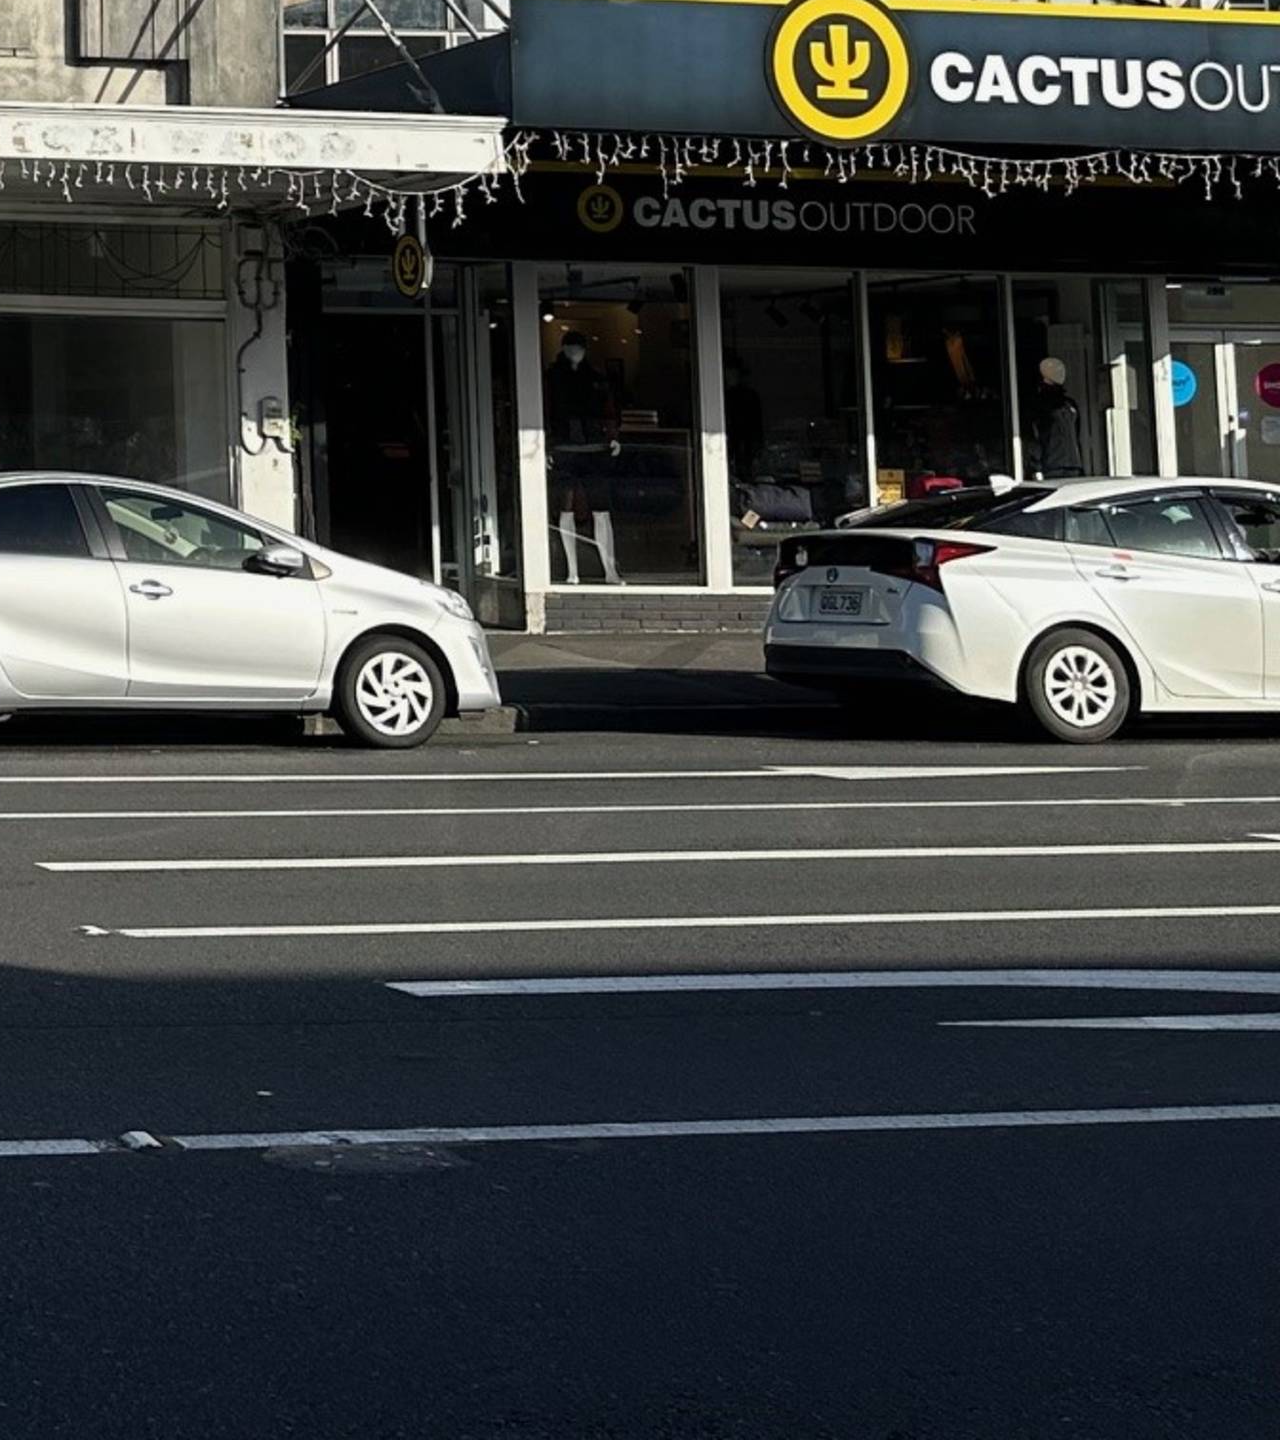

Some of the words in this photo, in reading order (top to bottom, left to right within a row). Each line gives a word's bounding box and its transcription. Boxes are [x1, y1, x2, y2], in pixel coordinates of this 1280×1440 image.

[930, 51, 1186, 110] CACTUS
[633, 197, 797, 231] CACTUS
[799, 201, 977, 235] OUTDOOR
